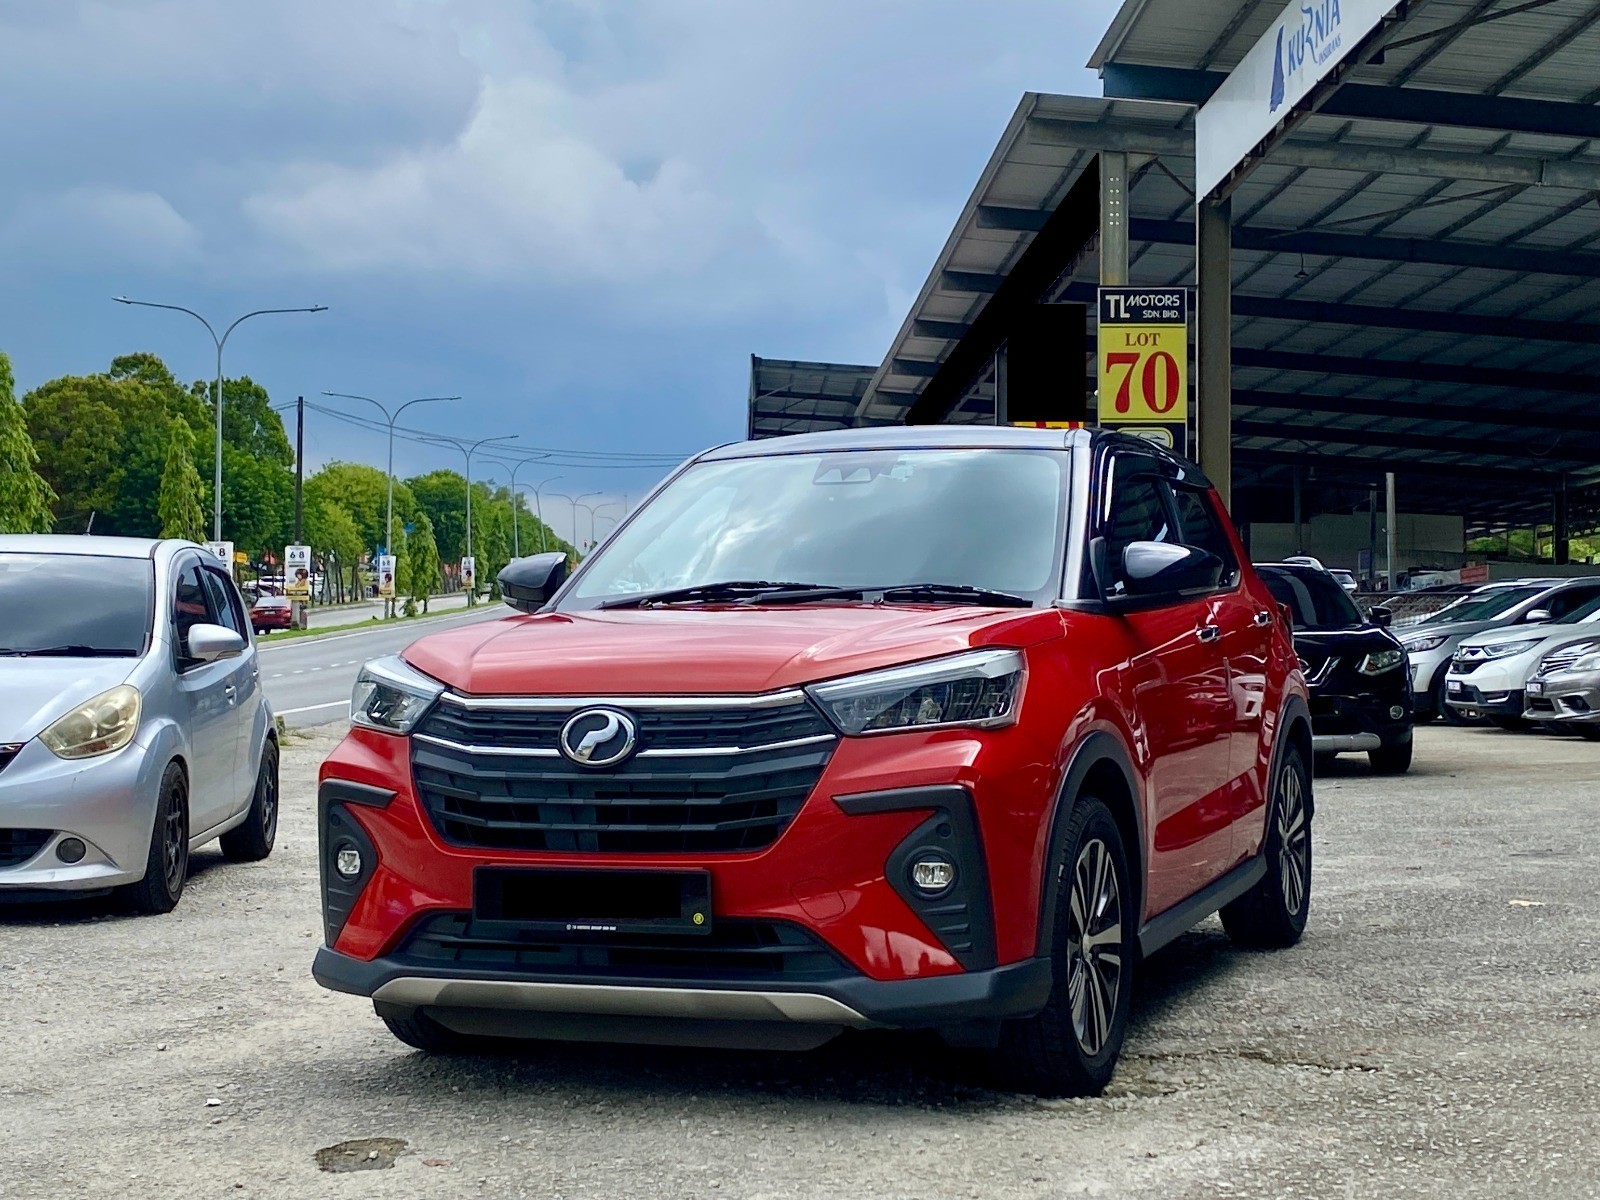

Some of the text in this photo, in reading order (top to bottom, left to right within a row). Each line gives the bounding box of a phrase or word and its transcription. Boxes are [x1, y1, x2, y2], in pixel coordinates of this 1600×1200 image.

[1288, 0, 1341, 76] KURNIA
[1105, 294, 1180, 319] TL MOTORS
[1125, 332, 1161, 347] LOT
[1105, 350, 1180, 414] 70
